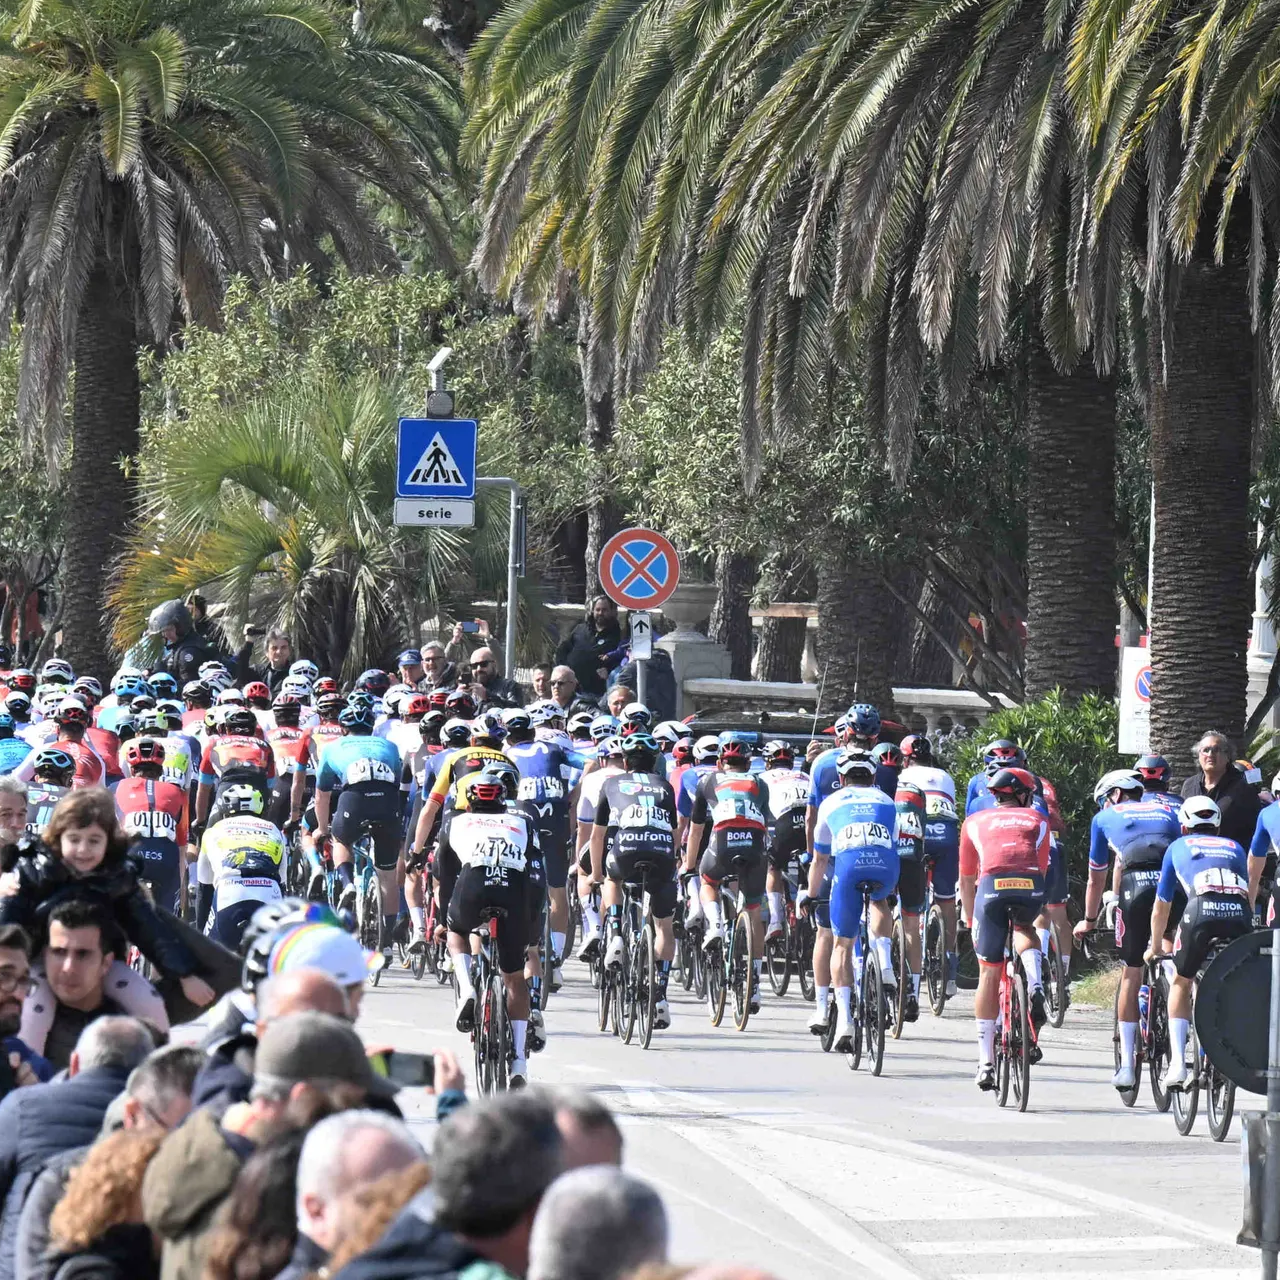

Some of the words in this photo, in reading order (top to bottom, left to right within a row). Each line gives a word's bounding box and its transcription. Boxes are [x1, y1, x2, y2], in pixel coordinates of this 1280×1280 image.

[418, 506, 452, 520] serie
[155, 812, 176, 832] 101
[792, 815, 805, 823] UA
[727, 831, 753, 840] BORA
[867, 822, 890, 840] 203
[619, 831, 673, 844] youfone
[500, 840, 522, 861] 247
[485, 866, 508, 878] UAE
[1135, 871, 1162, 881] BRUST
[1202, 901, 1242, 911] BRUSTOR
